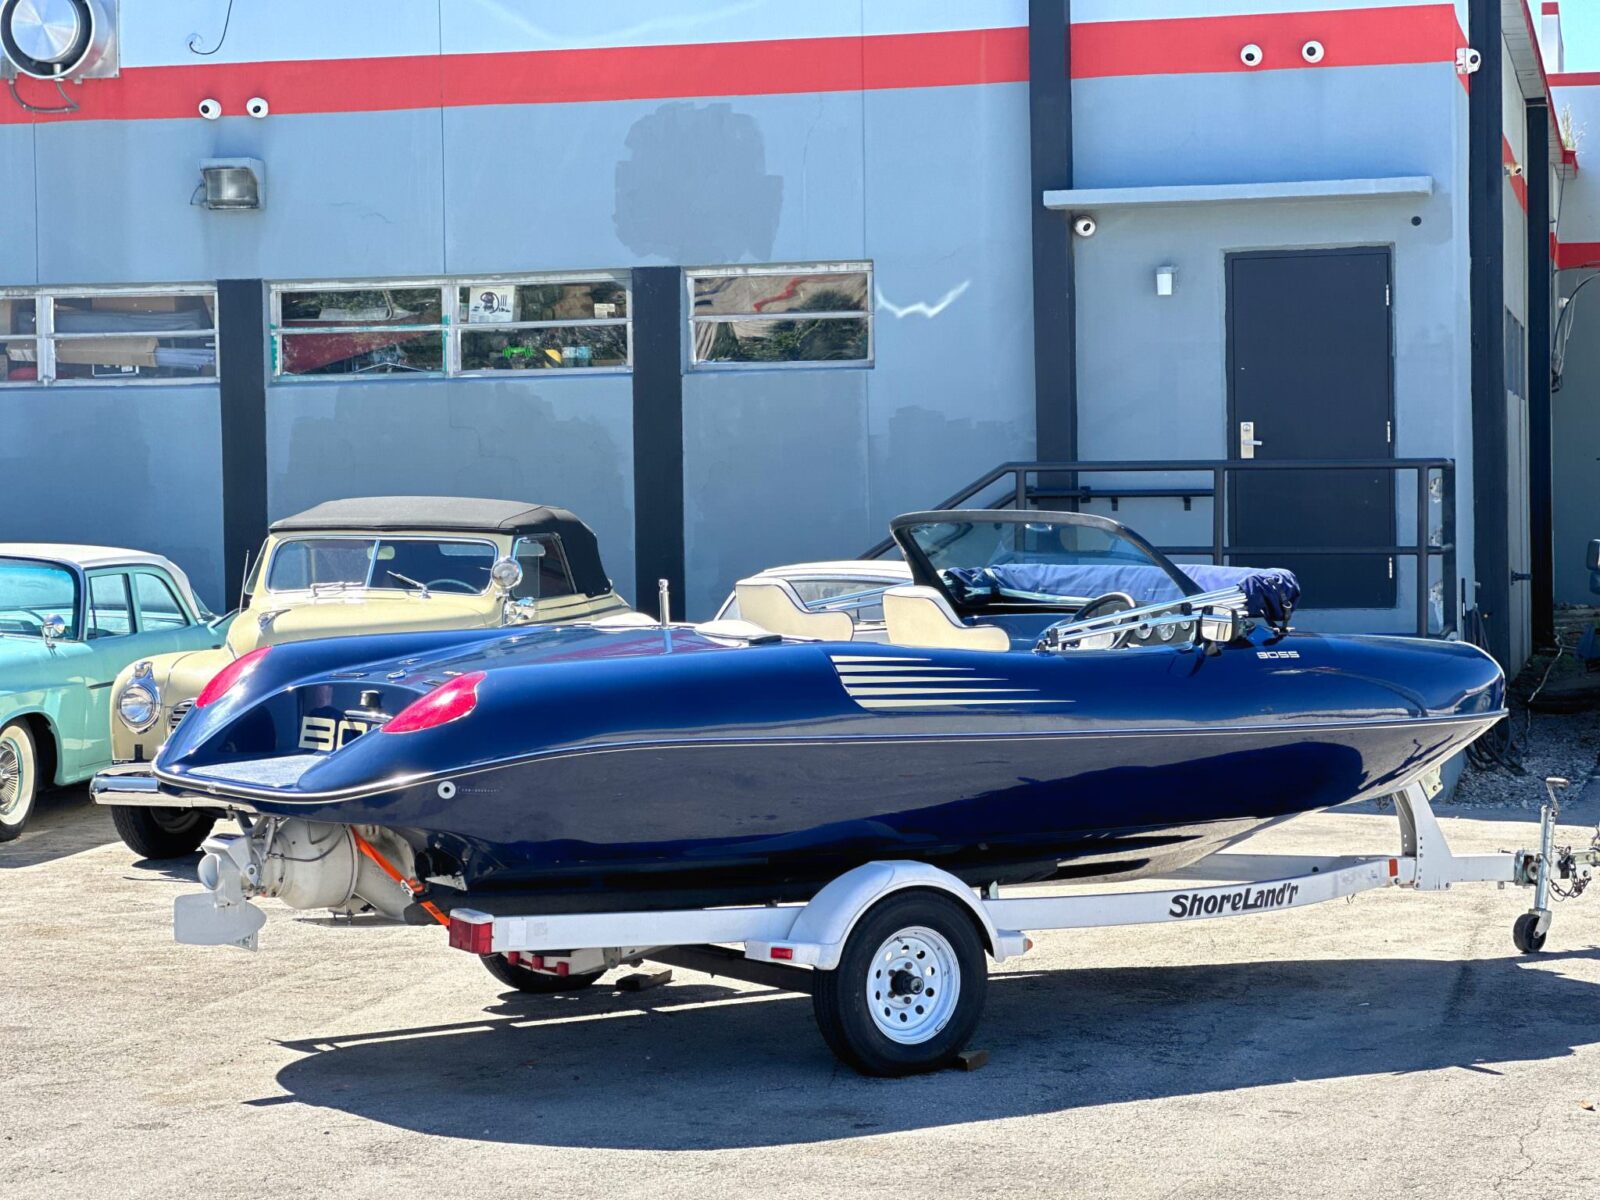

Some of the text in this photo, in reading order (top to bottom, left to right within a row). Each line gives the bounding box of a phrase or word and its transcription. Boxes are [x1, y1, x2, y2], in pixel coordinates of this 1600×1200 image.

[1256, 650, 1300, 659] BOSS
[298, 716, 383, 751] BO
[1169, 882, 1299, 918] ShoreLand'r
